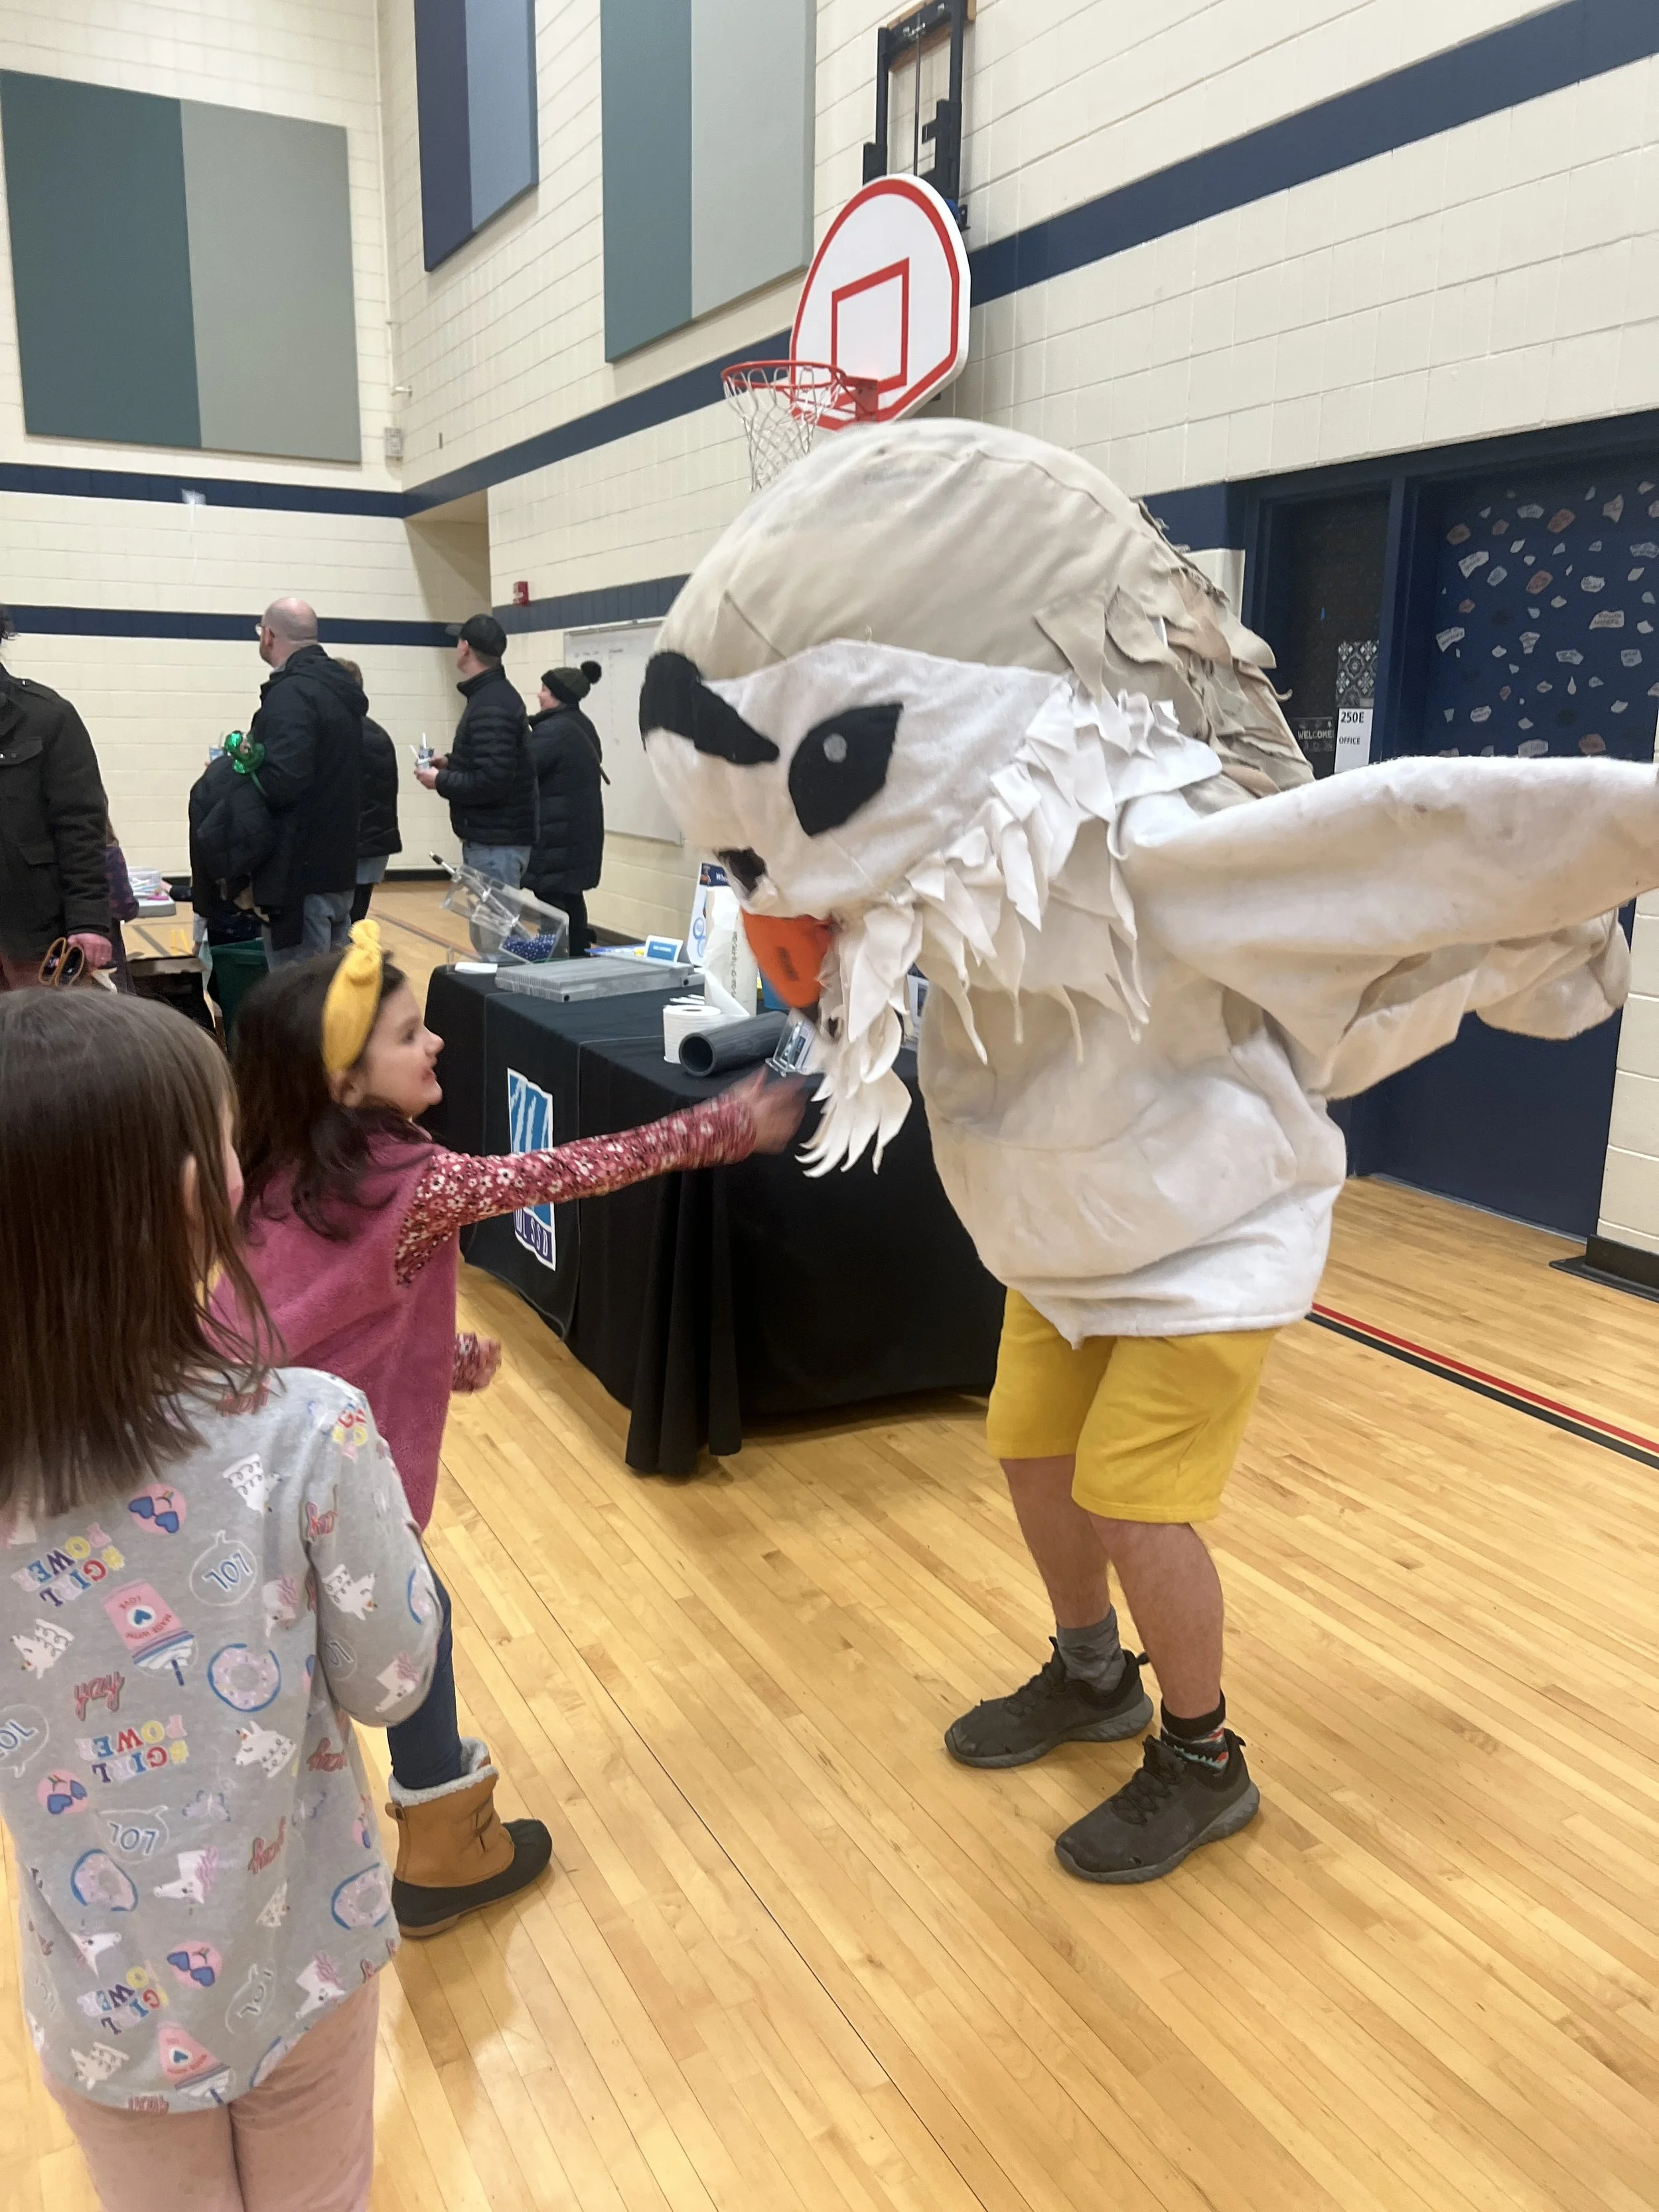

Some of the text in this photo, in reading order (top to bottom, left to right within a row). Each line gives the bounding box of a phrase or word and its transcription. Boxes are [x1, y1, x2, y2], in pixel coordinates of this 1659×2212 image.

[1340, 711, 1364, 723] 250E
[1338, 737, 1360, 745] OFFICE
[10, 1522, 112, 1592] POWER
[38, 1544, 126, 1608] #GIRL
[200, 1550, 255, 1595] LOL
[0, 1719, 38, 1759] OL
[74, 1714, 188, 1763] POWER
[92, 1738, 190, 1783] #GIRL
[107, 1821, 159, 1856] LOL
